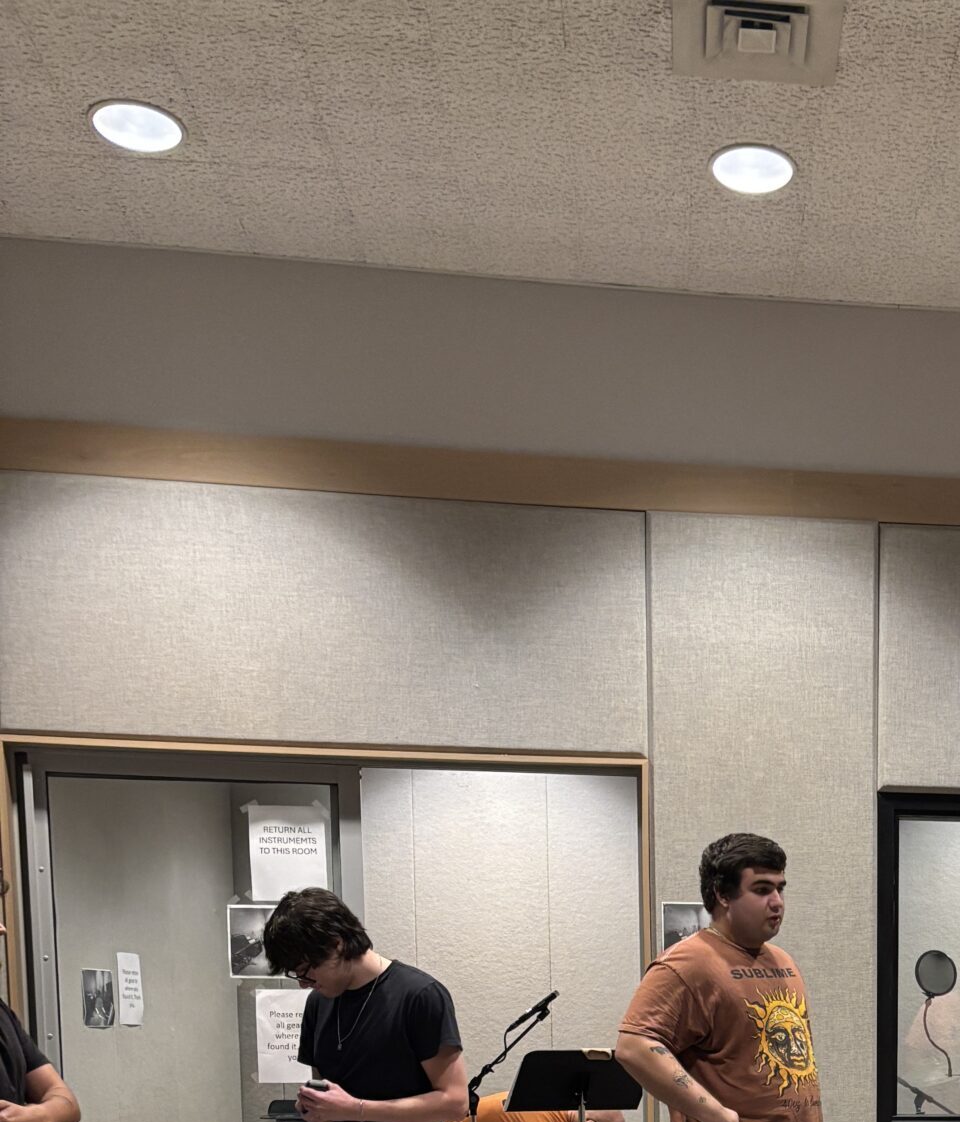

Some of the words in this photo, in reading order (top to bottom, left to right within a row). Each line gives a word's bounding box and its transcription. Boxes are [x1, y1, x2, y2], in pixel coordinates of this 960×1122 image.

[263, 826, 296, 834] RETURN
[297, 826, 312, 834] ALL
[260, 847, 271, 855] TO
[272, 847, 290, 855] THIS
[292, 847, 317, 855] ROOM
[730, 967, 796, 980] SUBLIME
[269, 1010, 294, 1019] Please
[275, 1032, 299, 1040] where
